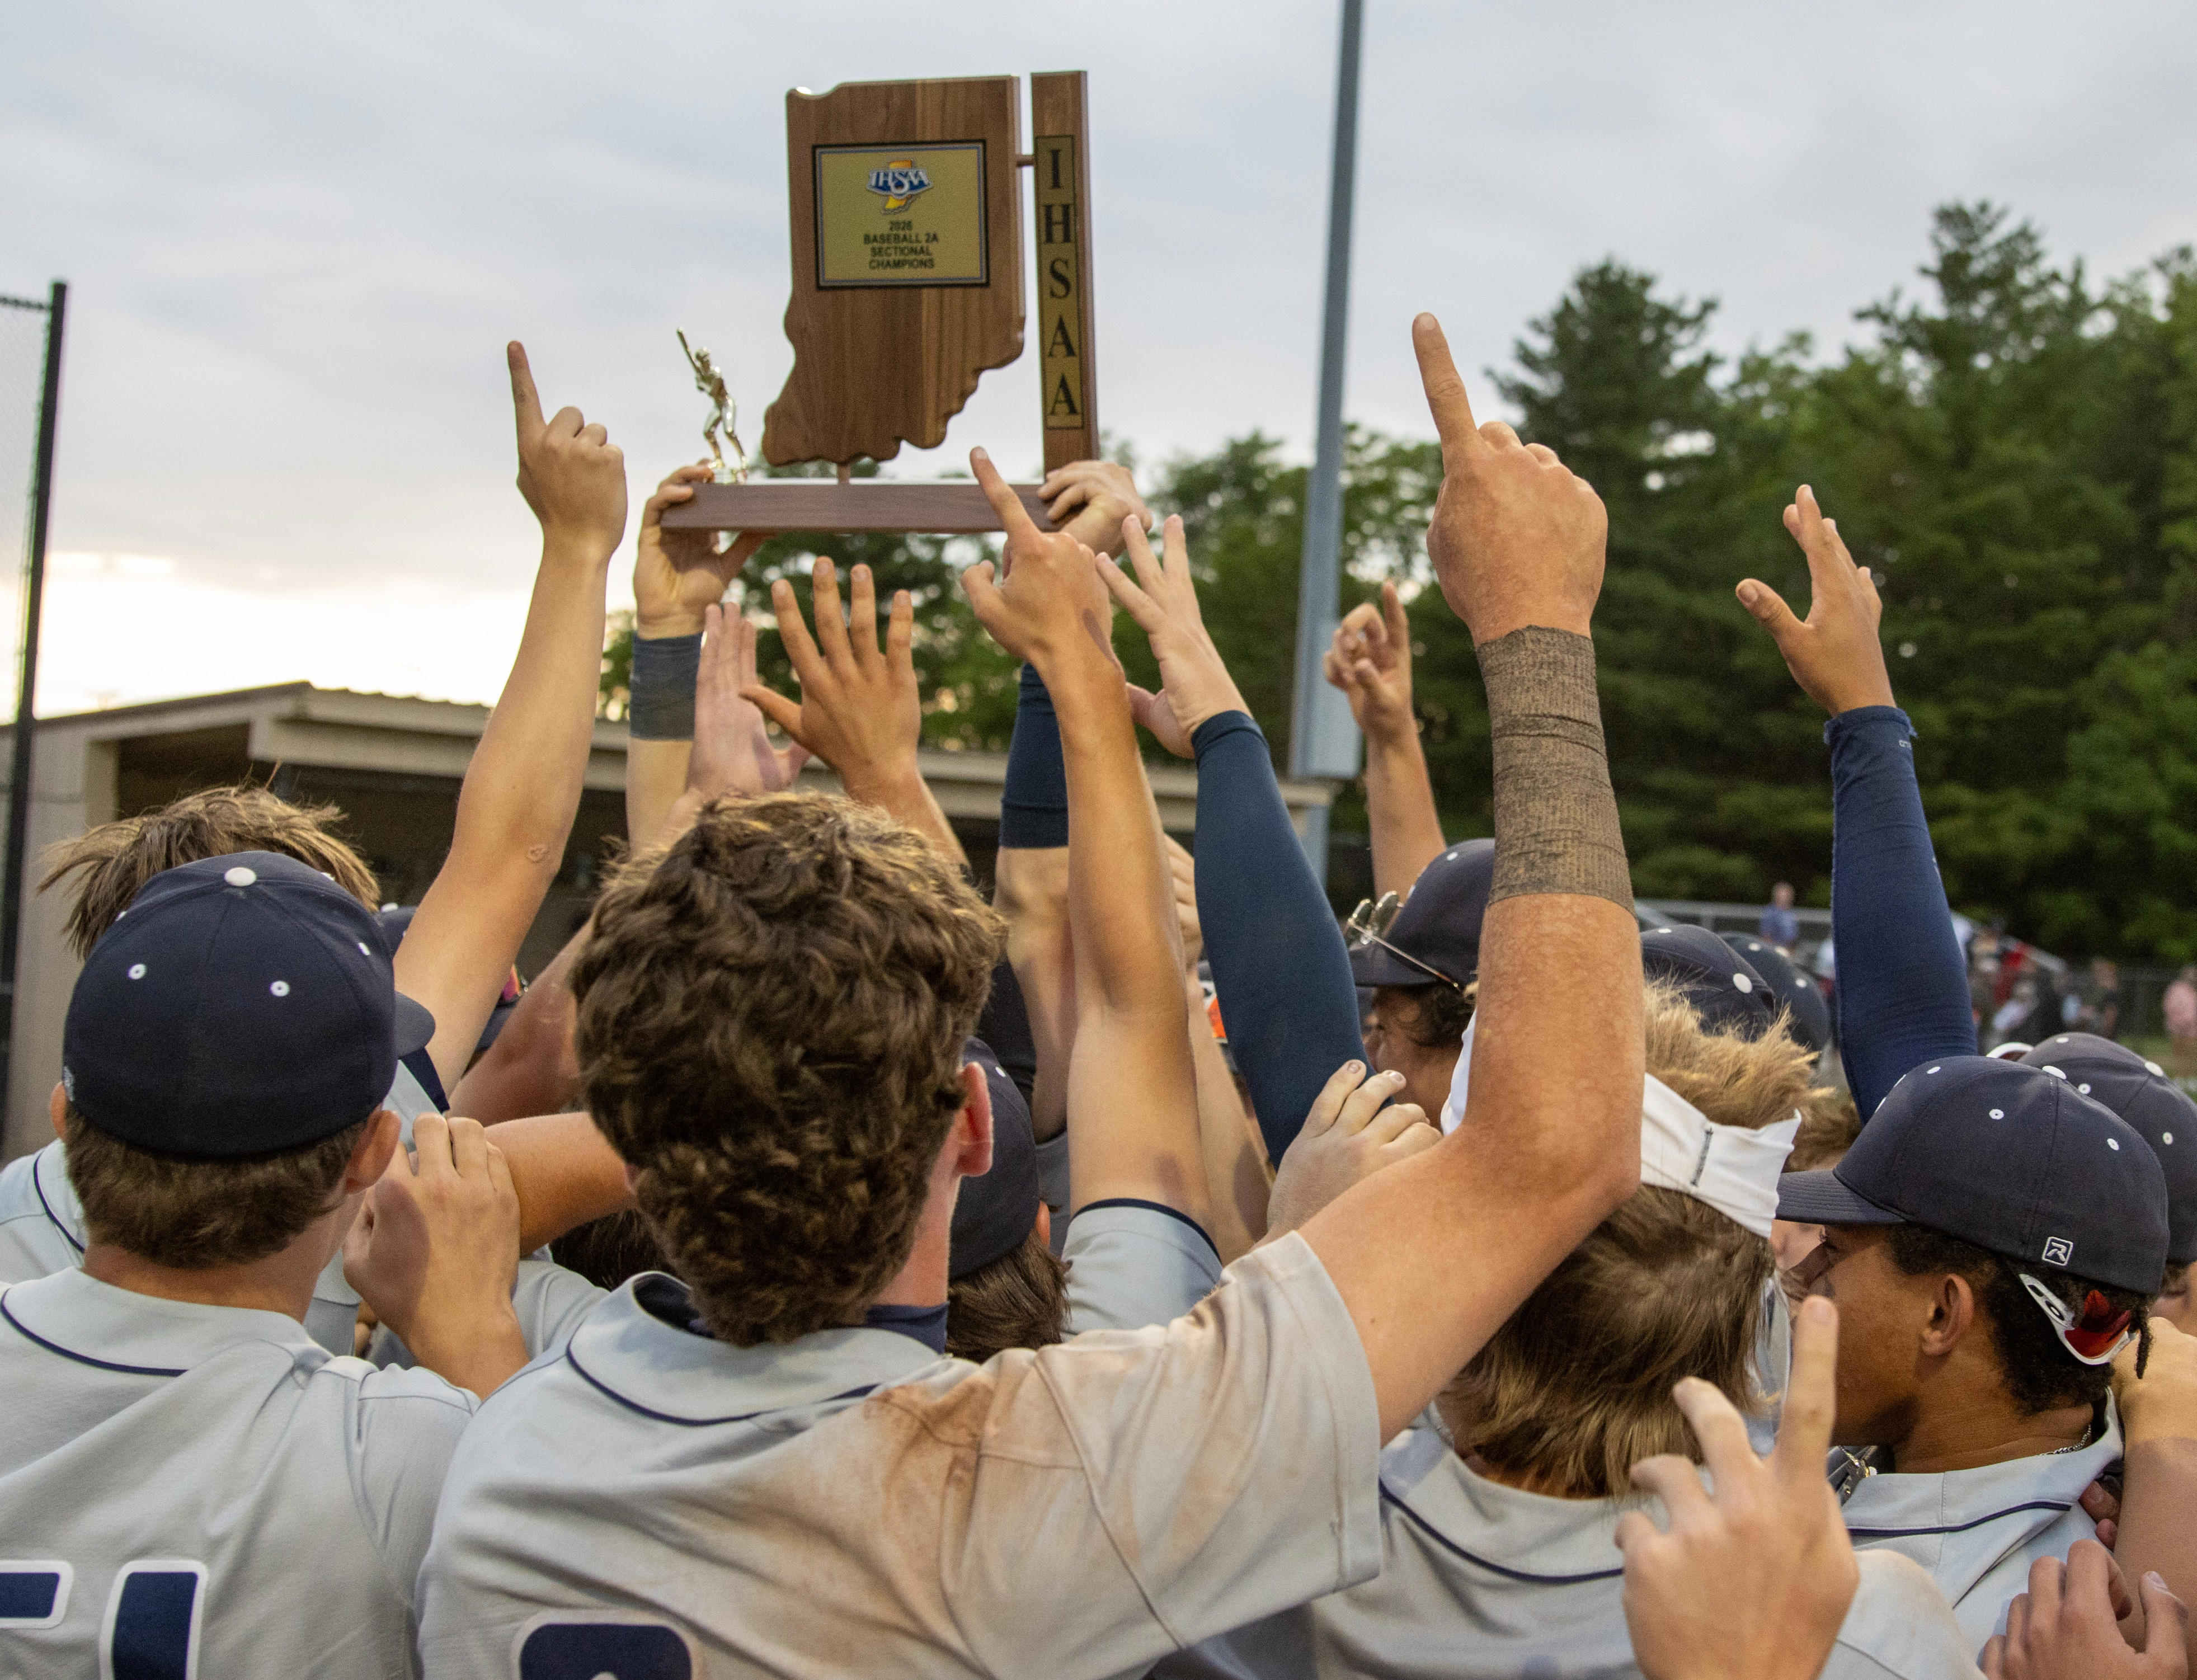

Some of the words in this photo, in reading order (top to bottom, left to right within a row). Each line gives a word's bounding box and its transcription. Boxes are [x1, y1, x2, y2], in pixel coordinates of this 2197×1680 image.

[863, 233, 922, 244] BASEBALL
[925, 232, 939, 243] 2A
[870, 246, 933, 257] SECTIONAL
[868, 258, 935, 269] CHAMPIONS
[1042, 149, 1079, 416] IHSAA
